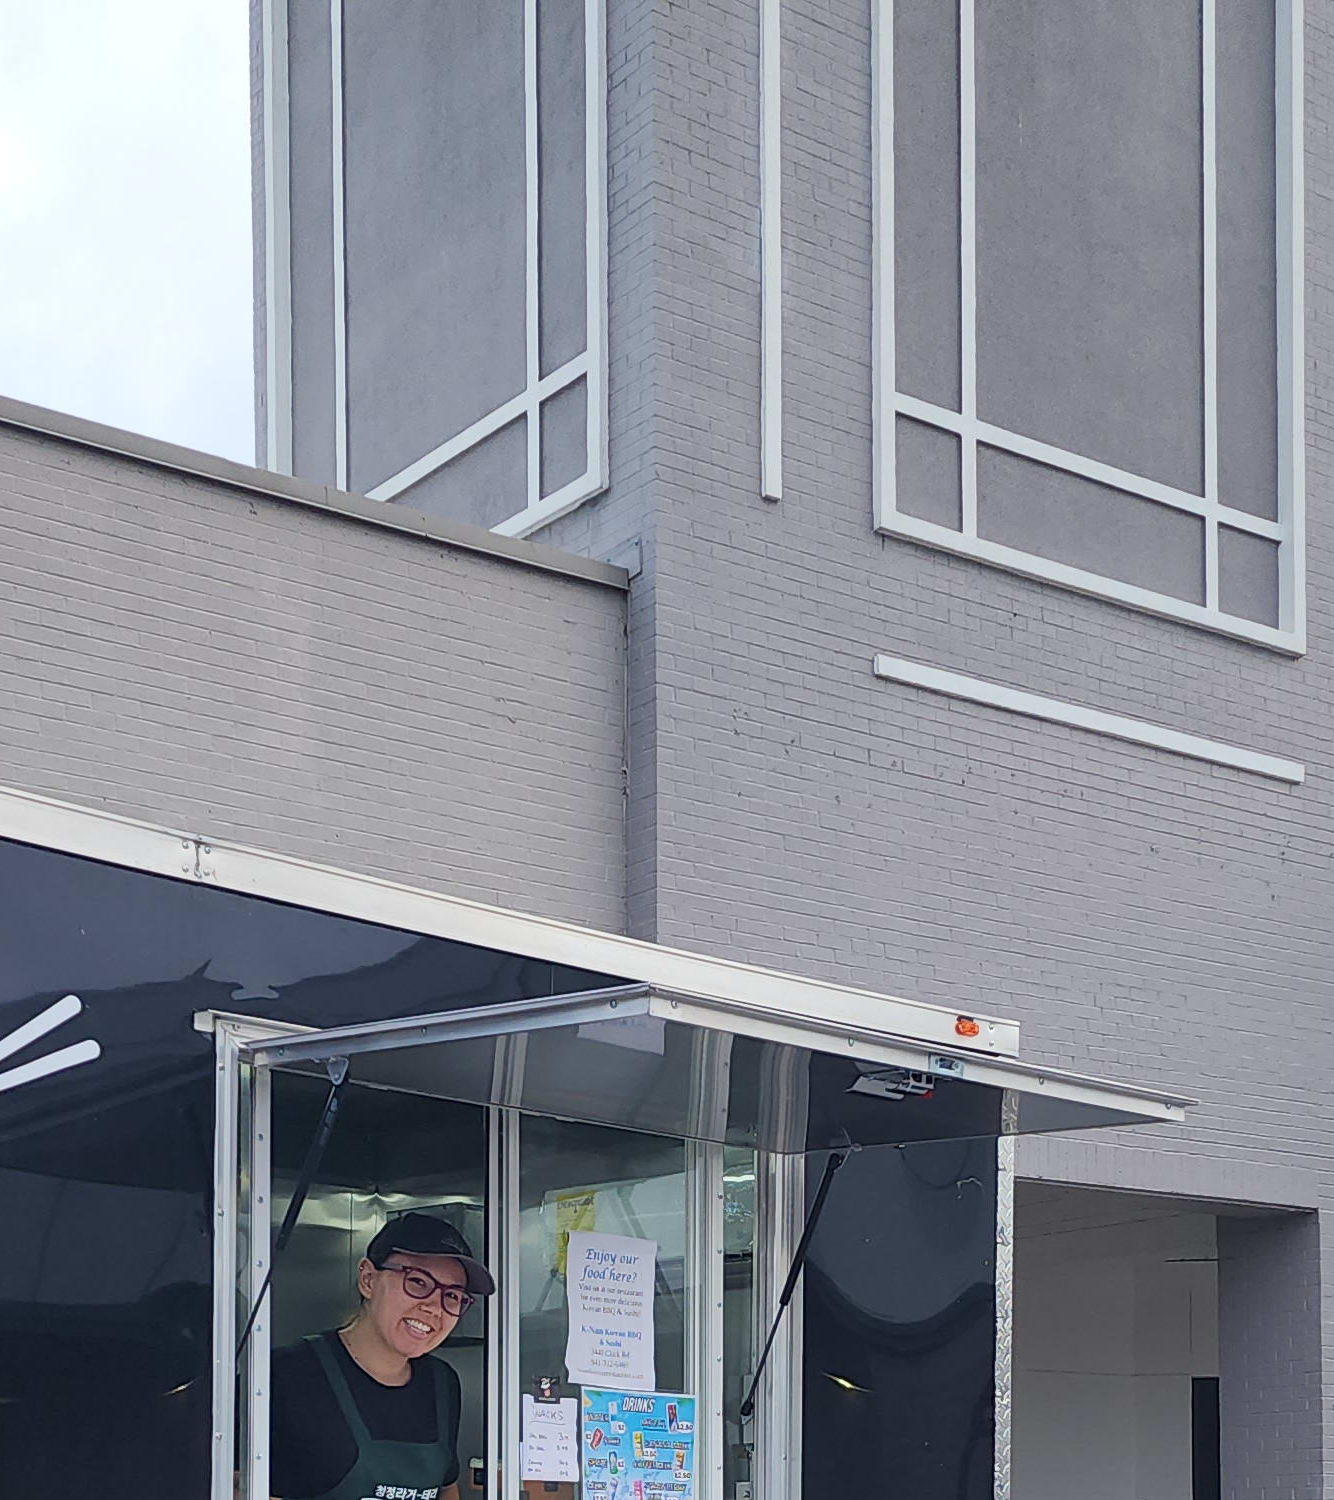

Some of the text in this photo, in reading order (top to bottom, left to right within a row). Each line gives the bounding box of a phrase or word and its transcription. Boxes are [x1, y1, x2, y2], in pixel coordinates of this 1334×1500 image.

[586, 1248, 639, 1266] Enjoy our
[580, 1265, 637, 1283] food here?
[622, 1397, 655, 1413] DRINKS
